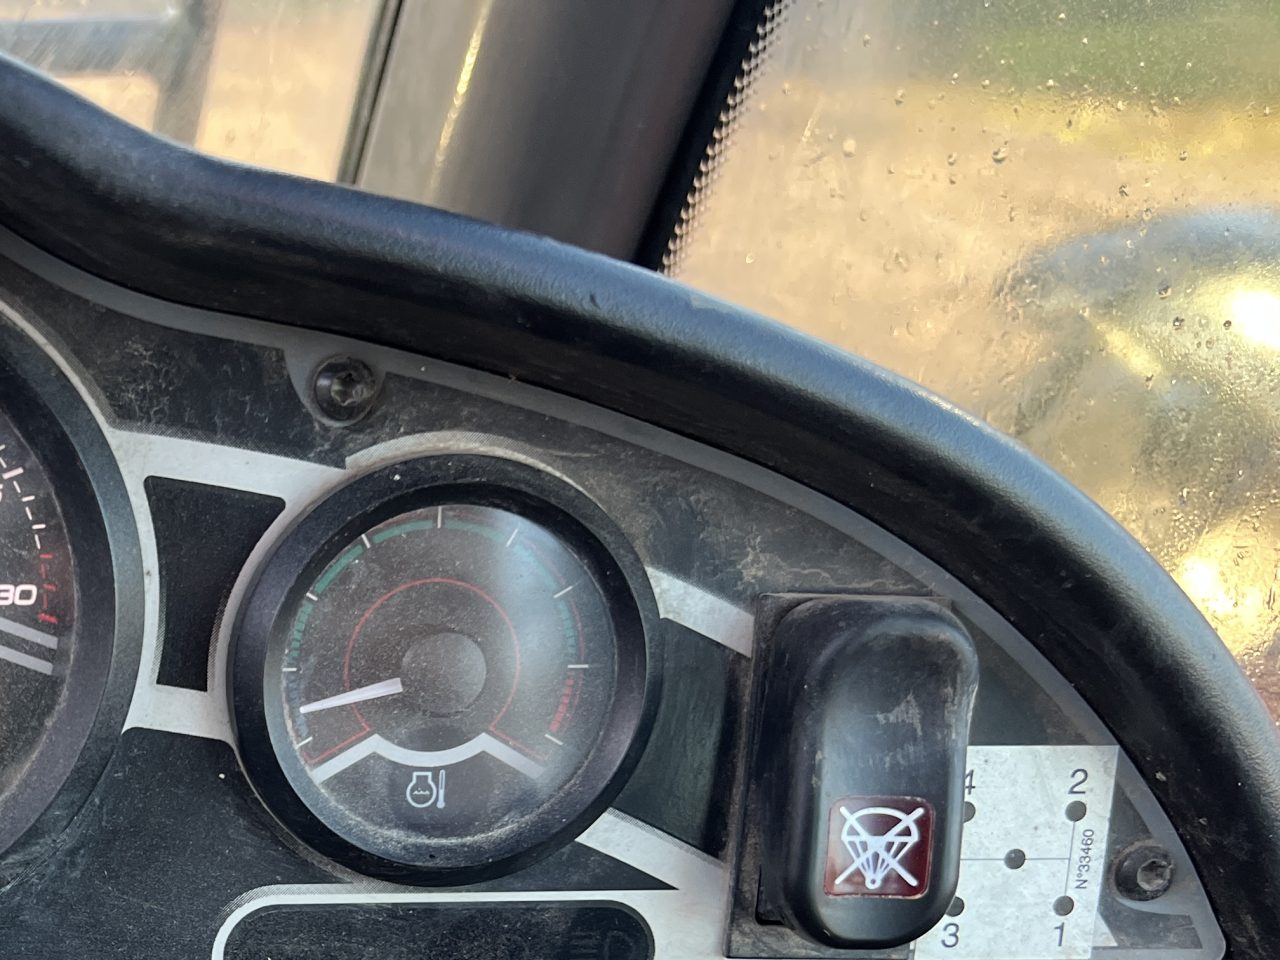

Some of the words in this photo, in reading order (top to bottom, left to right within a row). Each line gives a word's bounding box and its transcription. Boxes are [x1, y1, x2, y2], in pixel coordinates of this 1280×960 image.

[1067, 768, 1089, 795] 2
[1074, 828, 1095, 890] N°33460
[940, 922, 960, 948] 3
[1053, 921, 1066, 947] 1
